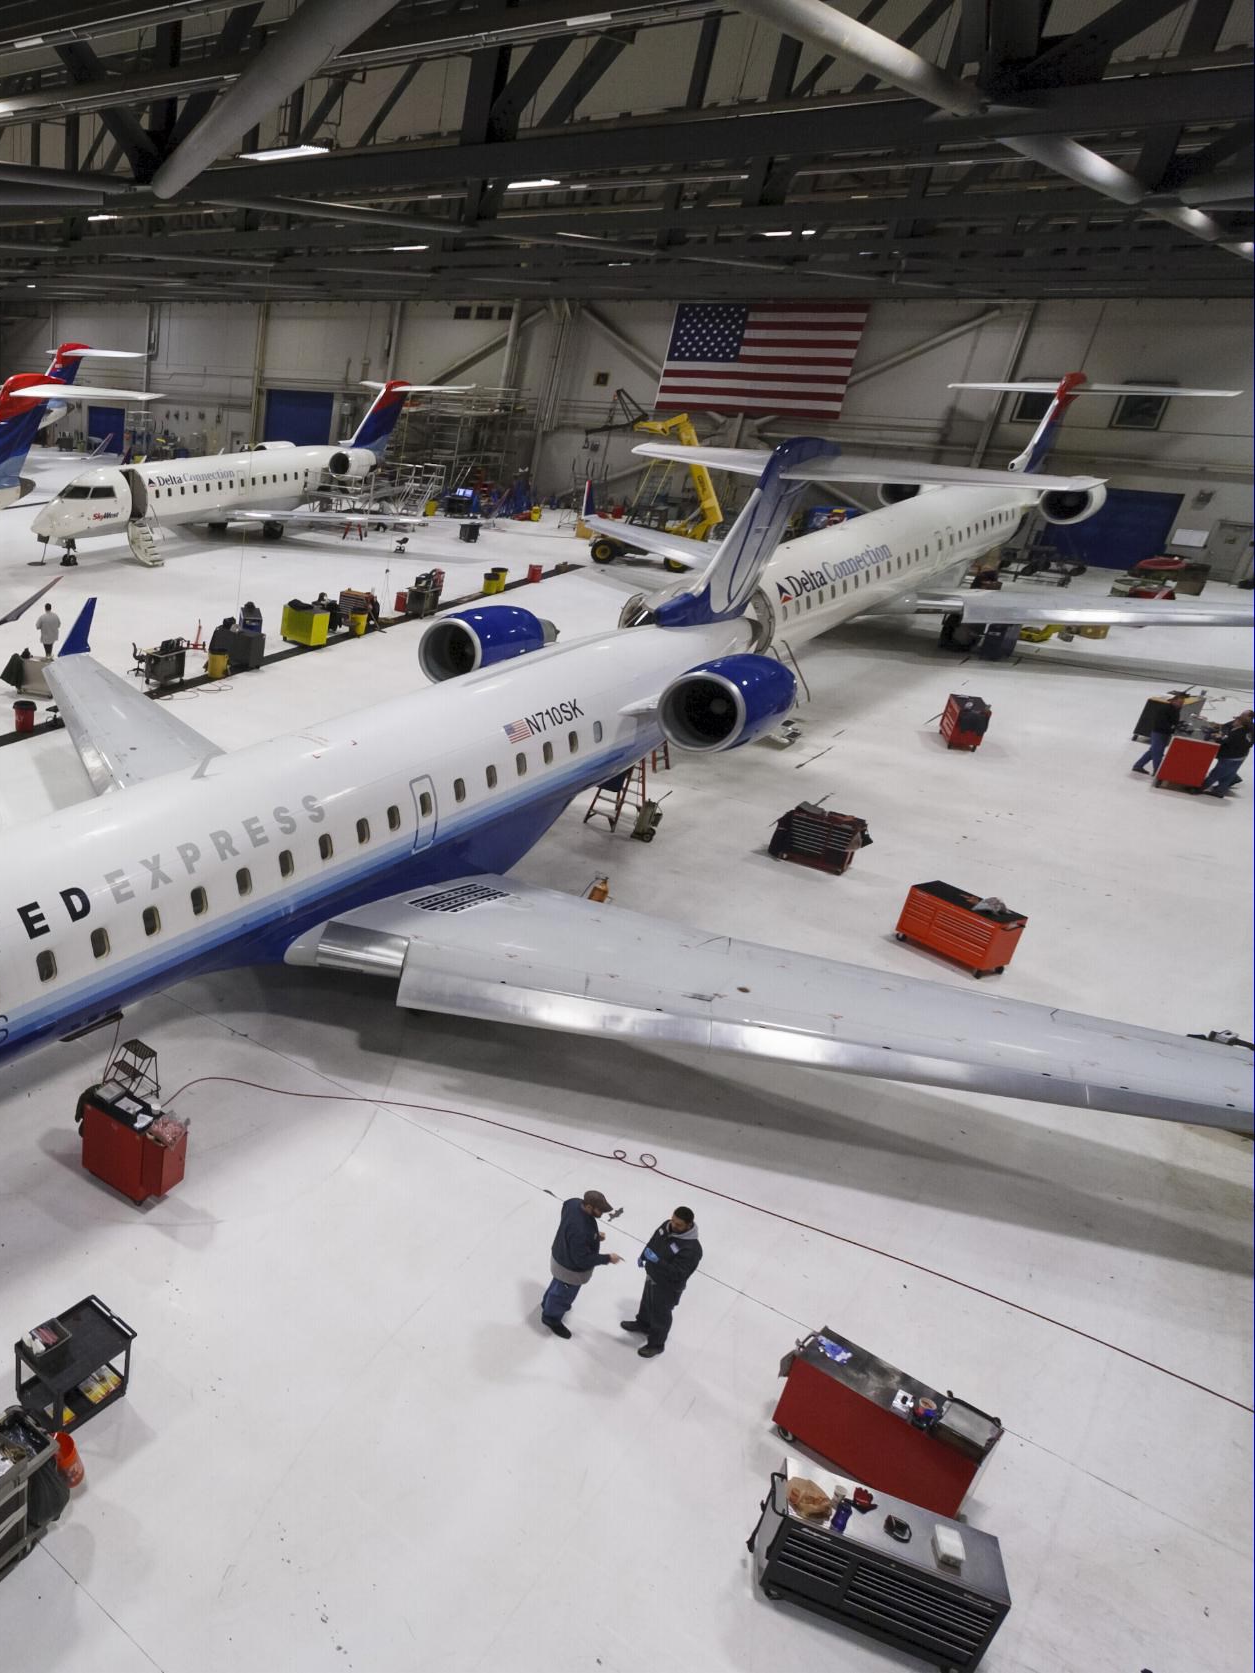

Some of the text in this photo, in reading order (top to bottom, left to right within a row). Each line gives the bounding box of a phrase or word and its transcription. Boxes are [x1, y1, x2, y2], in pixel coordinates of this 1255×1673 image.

[156, 469, 235, 487] Delta Connection
[92, 511, 119, 522] SkyWest
[785, 544, 893, 598] Delta Connection
[525, 698, 584, 735] N710SK
[103, 794, 327, 905] EXPRESS
